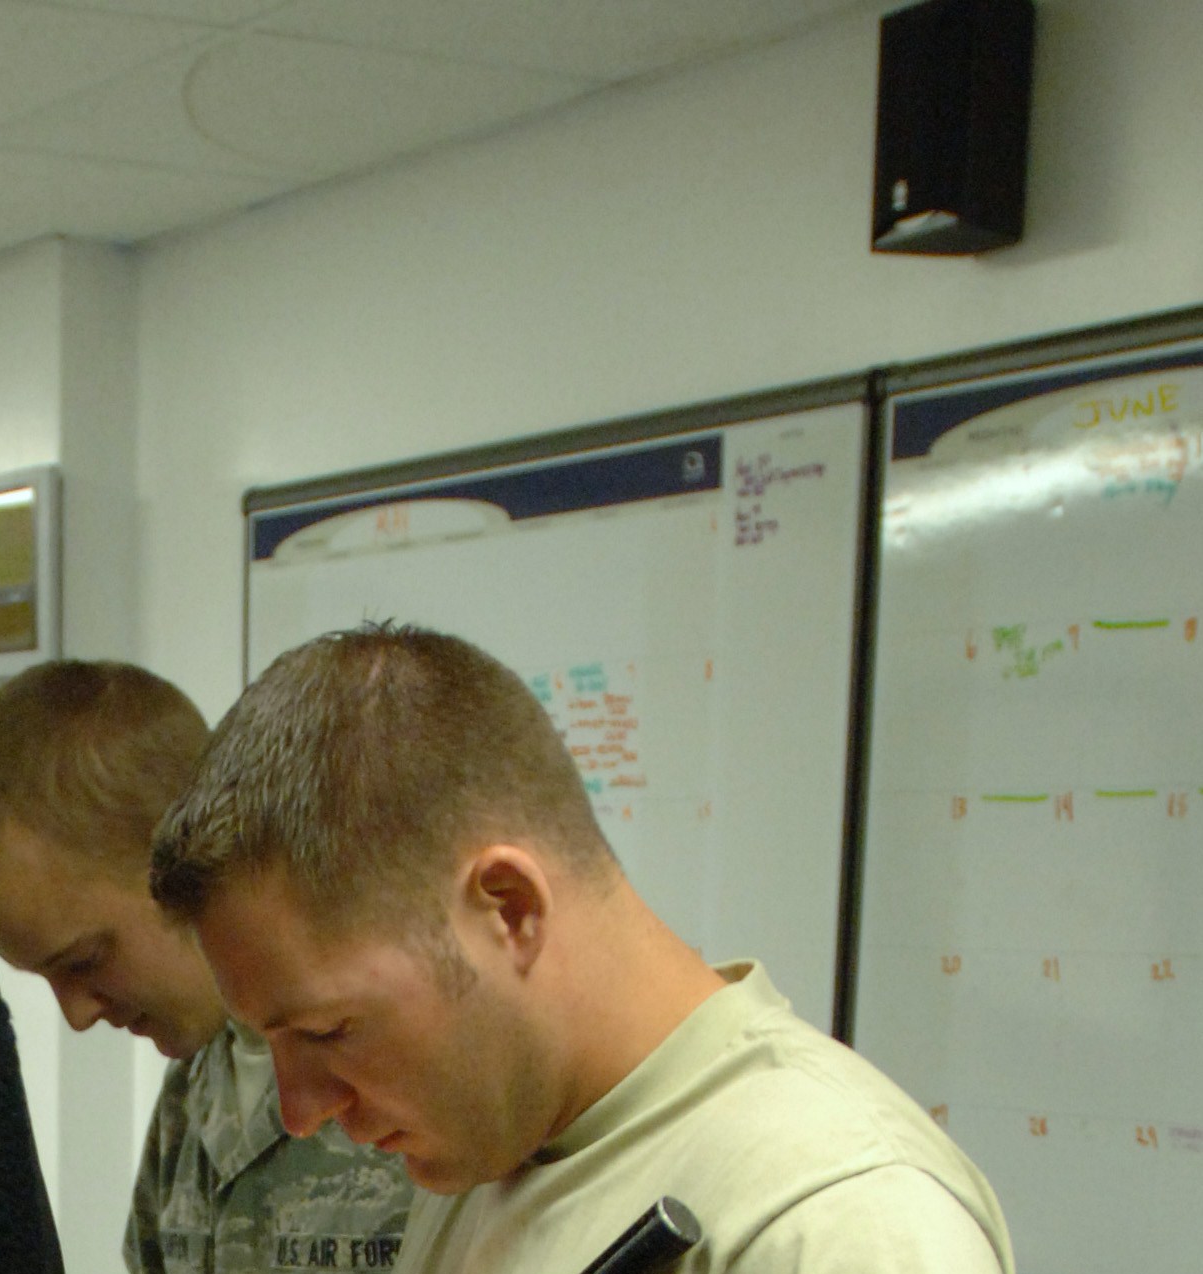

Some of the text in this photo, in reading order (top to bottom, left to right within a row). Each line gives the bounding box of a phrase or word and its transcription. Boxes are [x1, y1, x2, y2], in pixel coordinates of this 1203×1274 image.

[1073, 382, 1180, 429] JUNE
[940, 955, 962, 975] 20
[1150, 958, 1176, 981] 22
[308, 1237, 338, 1268] AIR
